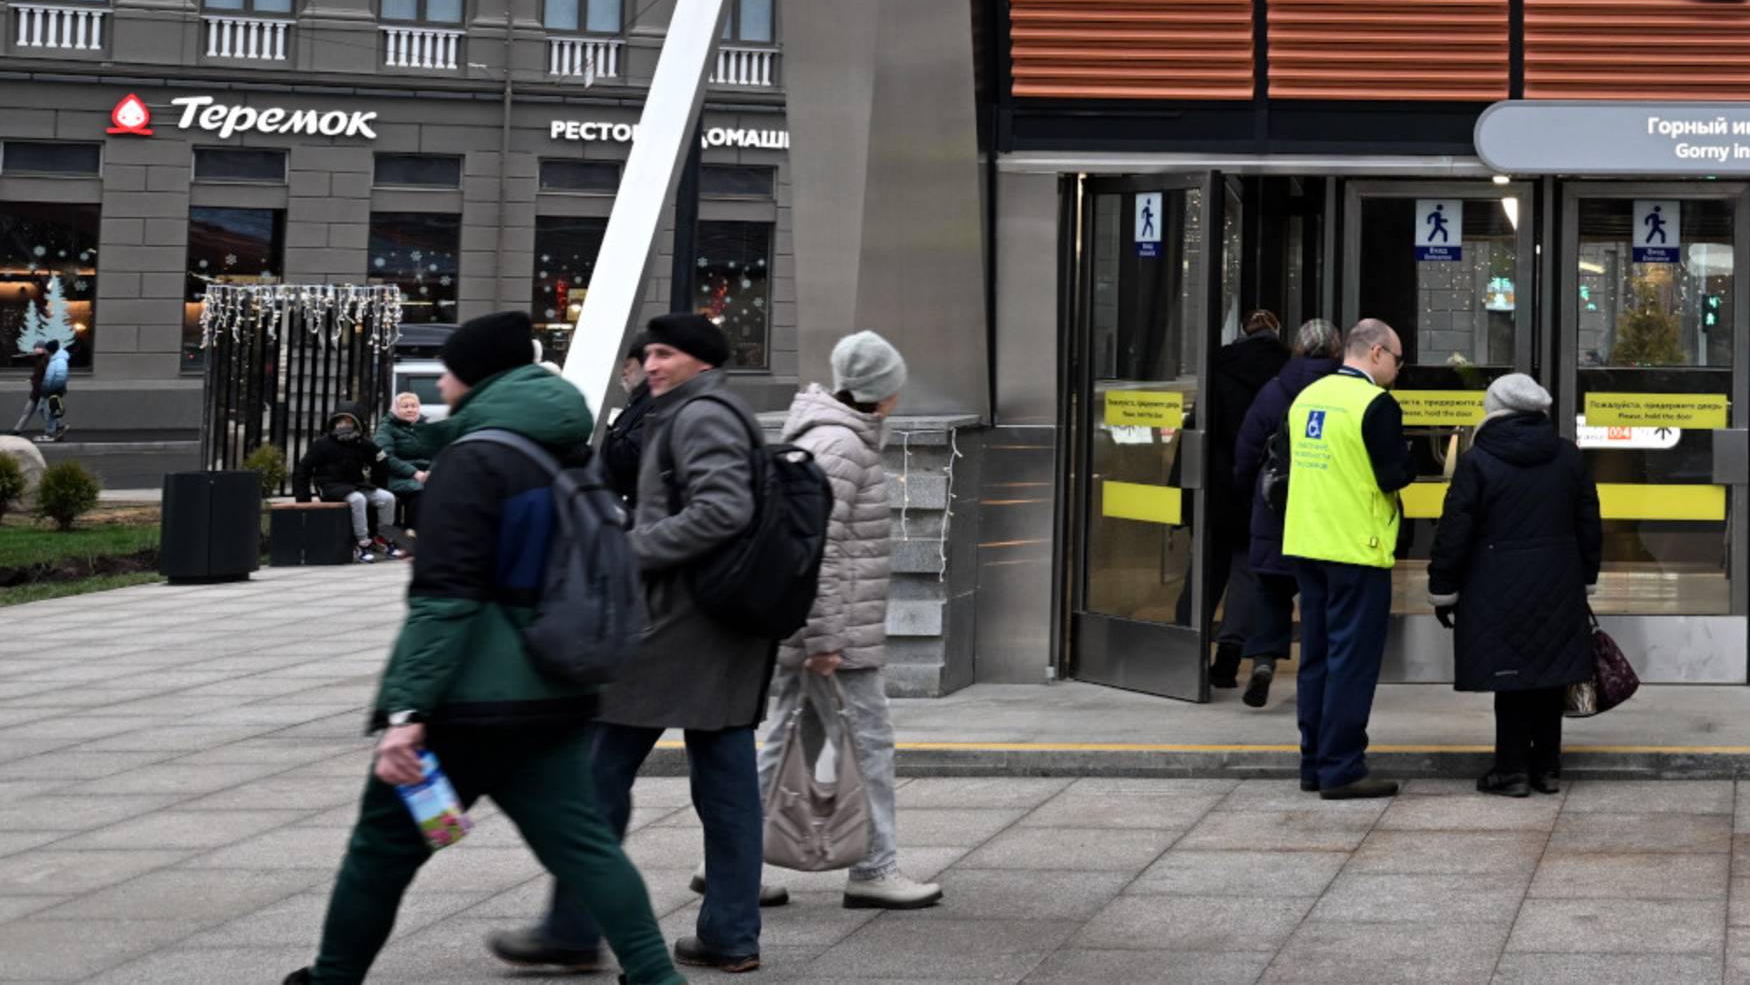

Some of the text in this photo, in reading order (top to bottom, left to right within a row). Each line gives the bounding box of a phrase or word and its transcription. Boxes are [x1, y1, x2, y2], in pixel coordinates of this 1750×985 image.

[170, 95, 378, 139] Теремок
[1647, 117, 1728, 139] Горный
[551, 120, 790, 149] РЕСТО ОМАШ
[1675, 142, 1731, 162] Gorny
